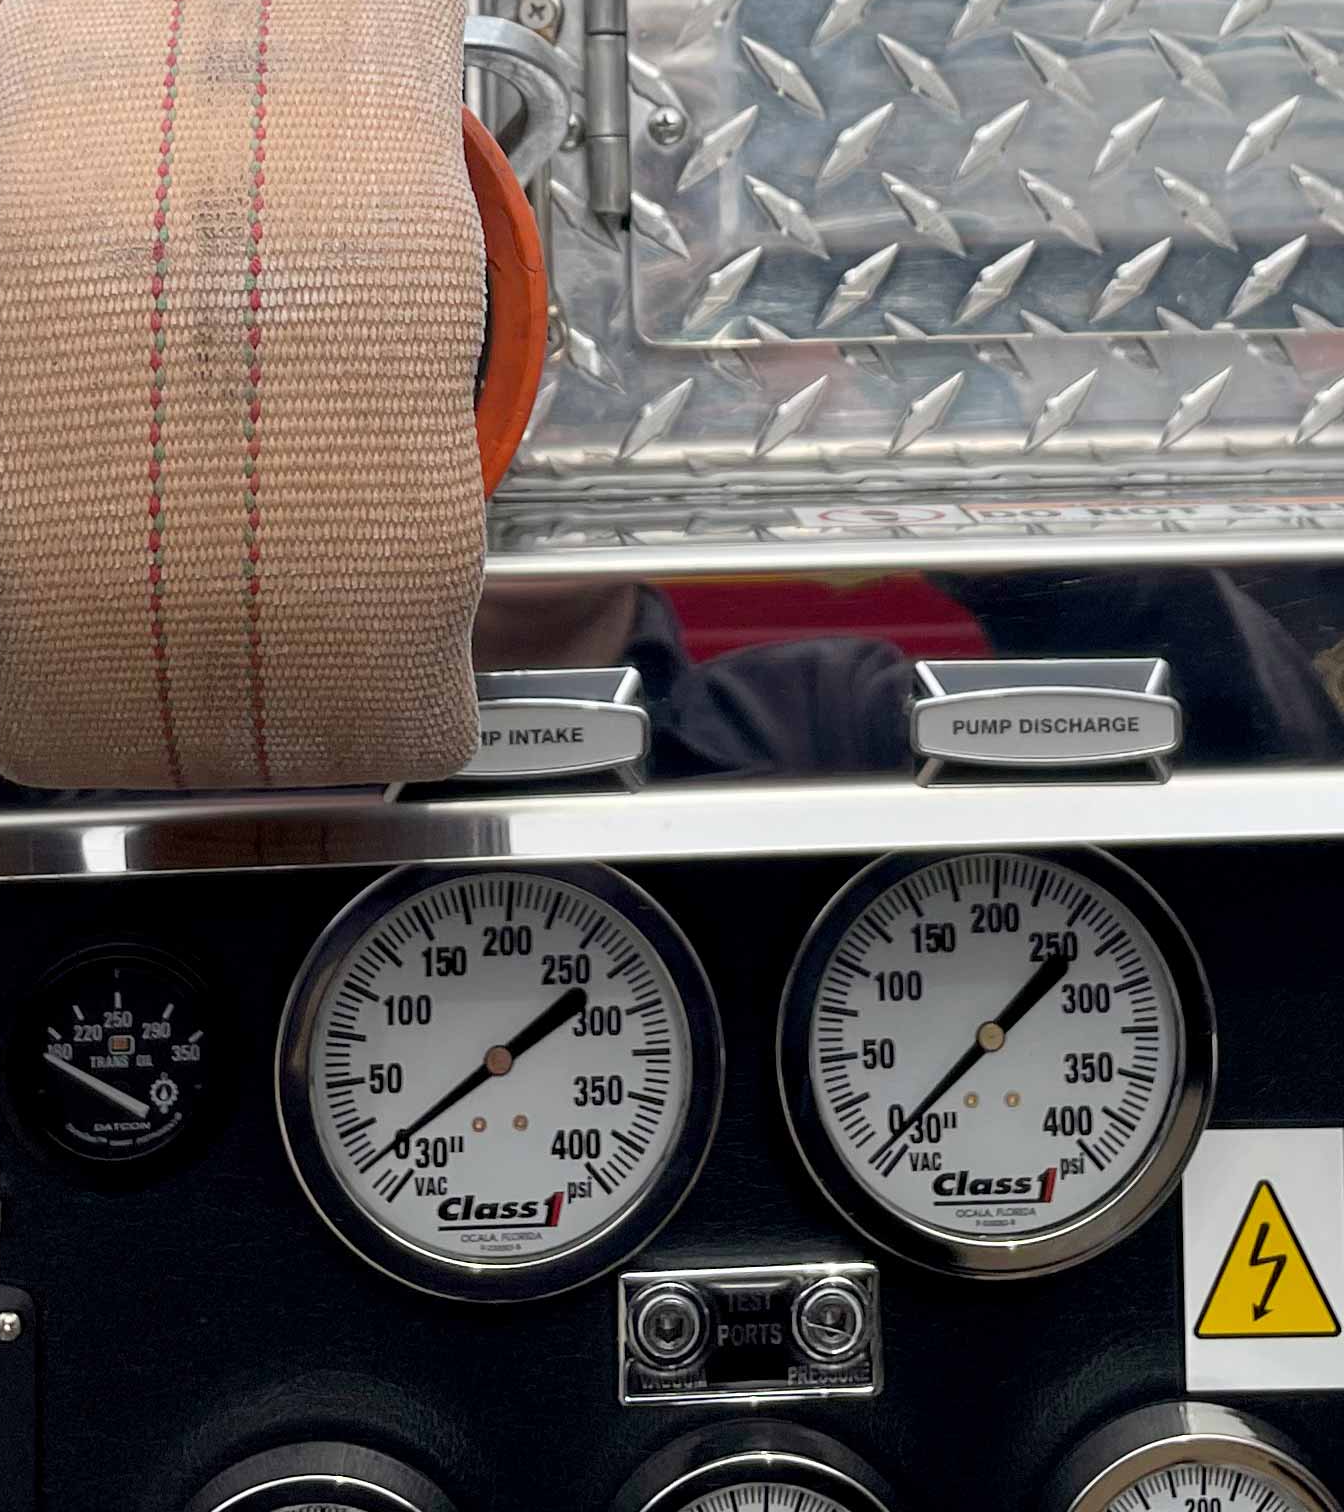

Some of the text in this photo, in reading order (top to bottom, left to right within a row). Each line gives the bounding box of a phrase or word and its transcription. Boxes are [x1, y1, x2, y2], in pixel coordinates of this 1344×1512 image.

[508, 727, 584, 745] INTAKE
[952, 716, 1140, 735] PUMP DISCHARGE
[970, 903, 1019, 933] 200
[482, 926, 532, 956] 200
[911, 922, 955, 953] 150
[1029, 931, 1078, 962] 250
[421, 946, 467, 977] 150
[541, 954, 591, 985] 250
[874, 971, 922, 1001] 100
[1061, 983, 1110, 1013] 300
[103, 1010, 133, 1028] 250
[384, 995, 431, 1026] 100
[573, 1006, 621, 1037] 300
[72, 1024, 103, 1042] 220
[141, 1021, 172, 1040] 290
[89, 1055, 129, 1068] TRANS
[171, 1044, 201, 1062] 350
[862, 1038, 895, 1069] 50
[1064, 1053, 1113, 1083] 350
[368, 1064, 402, 1094] 50
[573, 1075, 623, 1106] 350
[888, 1105, 903, 1135] 0
[1043, 1106, 1092, 1136] 400
[394, 1129, 411, 1159] 0
[551, 1129, 601, 1159] 400
[909, 1152, 942, 1171] VAC
[1060, 1152, 1085, 1178] psi
[414, 1176, 448, 1196] VAC
[567, 1176, 593, 1203] psi
[726, 1292, 772, 1312] TEST
[717, 1322, 784, 1347] PORTS
